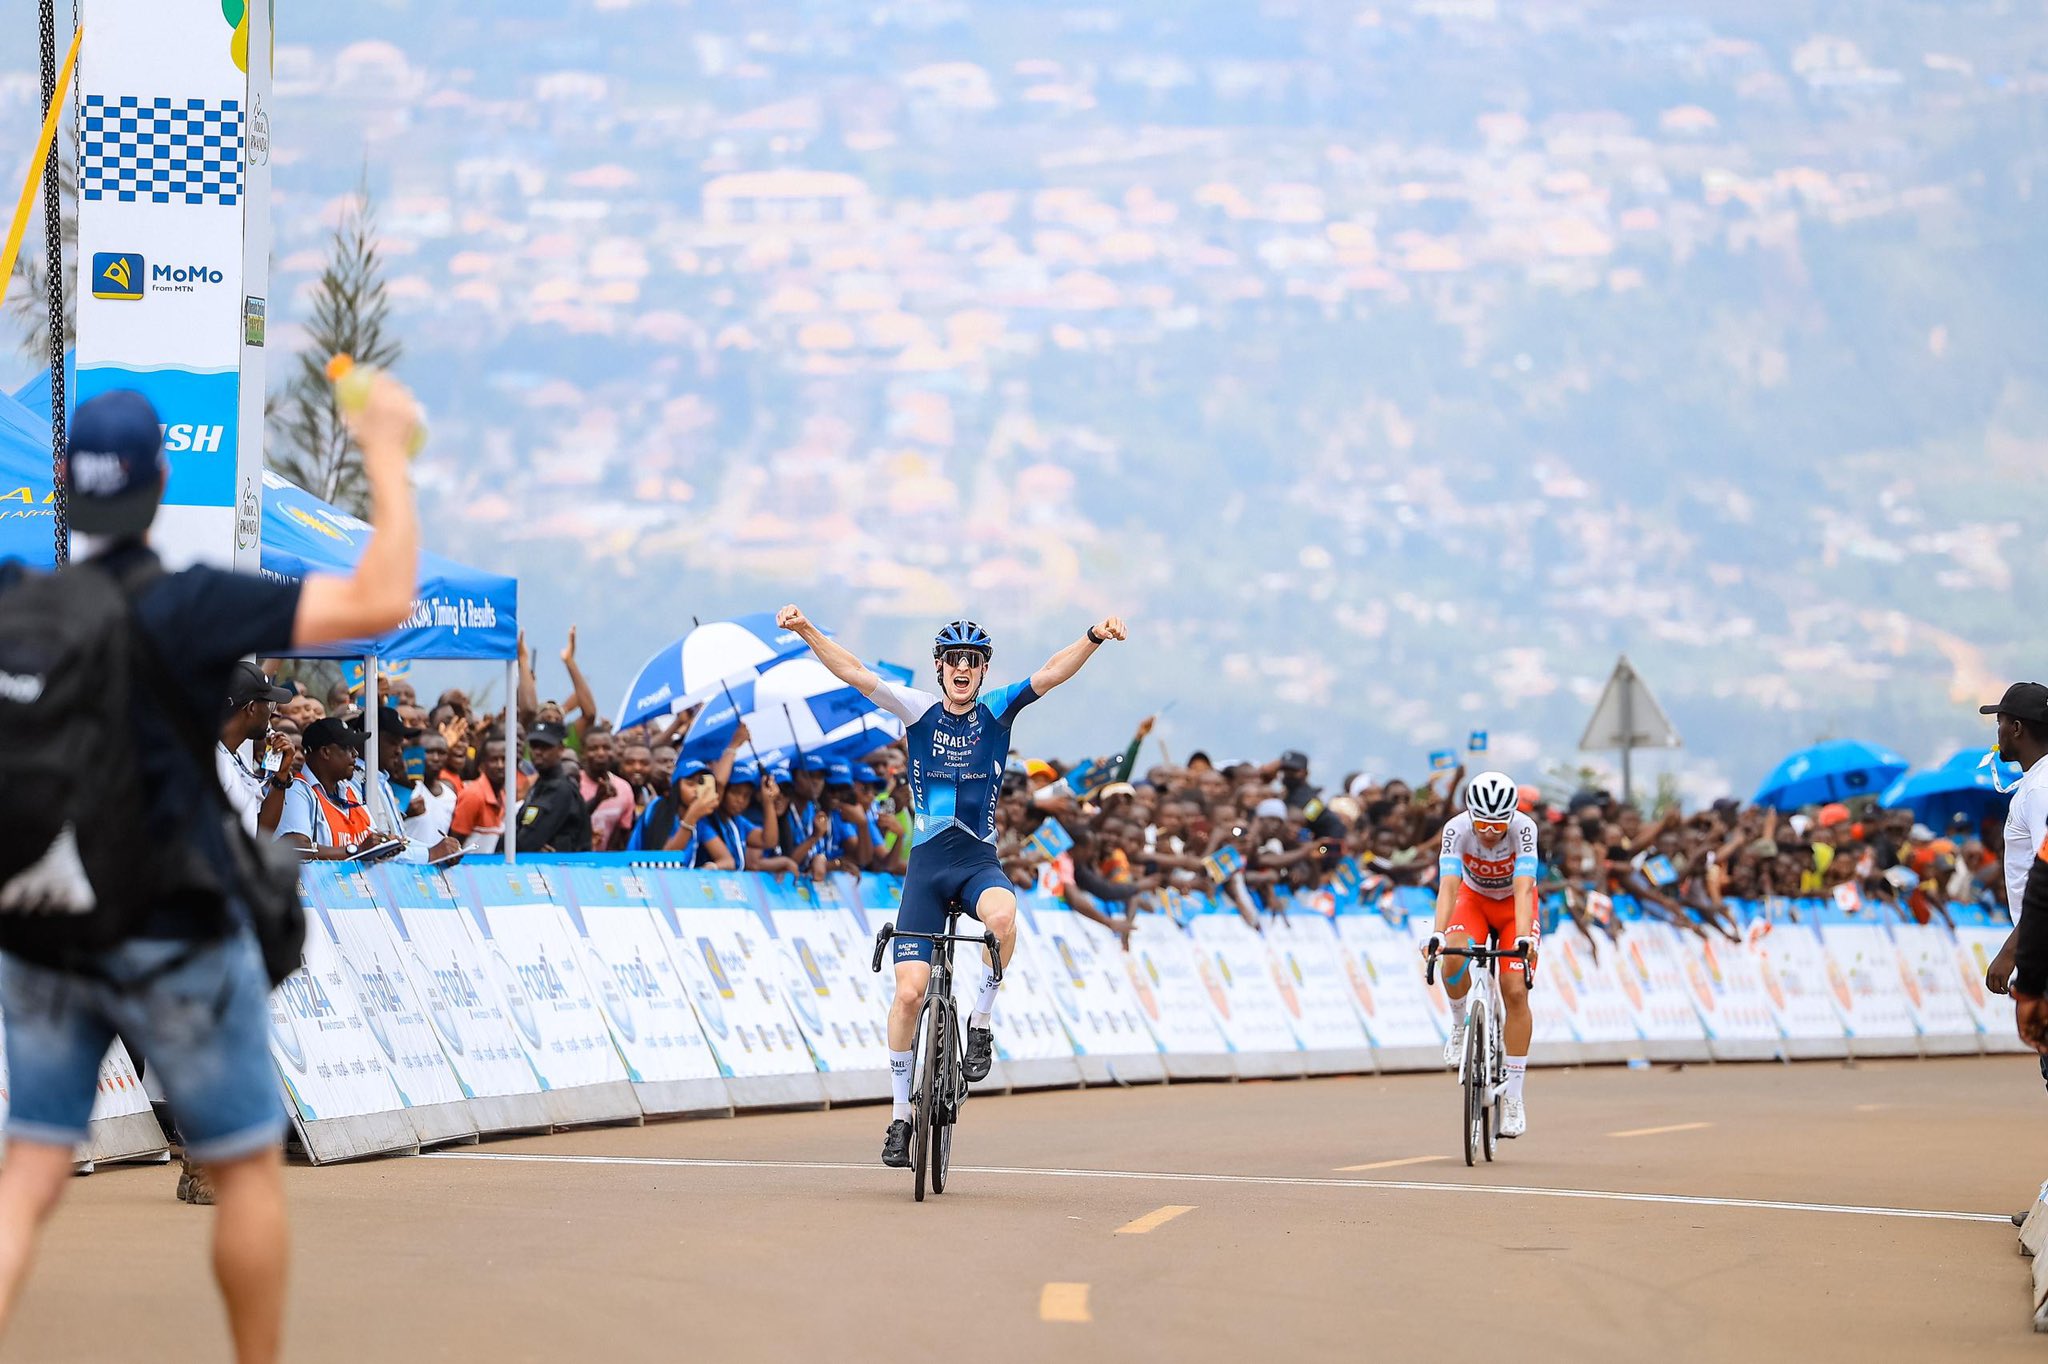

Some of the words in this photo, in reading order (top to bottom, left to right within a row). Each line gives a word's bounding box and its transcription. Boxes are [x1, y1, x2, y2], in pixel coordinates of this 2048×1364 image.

[152, 264, 223, 284] MoMo
[152, 284, 173, 292] from
[174, 285, 194, 293] MTN
[431, 596, 459, 636] Timing
[459, 598, 467, 628] &
[467, 596, 497, 629] Results
[933, 729, 968, 748] ISRAEL
[913, 759, 924, 810] FACTOR
[987, 784, 998, 832] FACTOR
[897, 950, 920, 958] CHANGE
